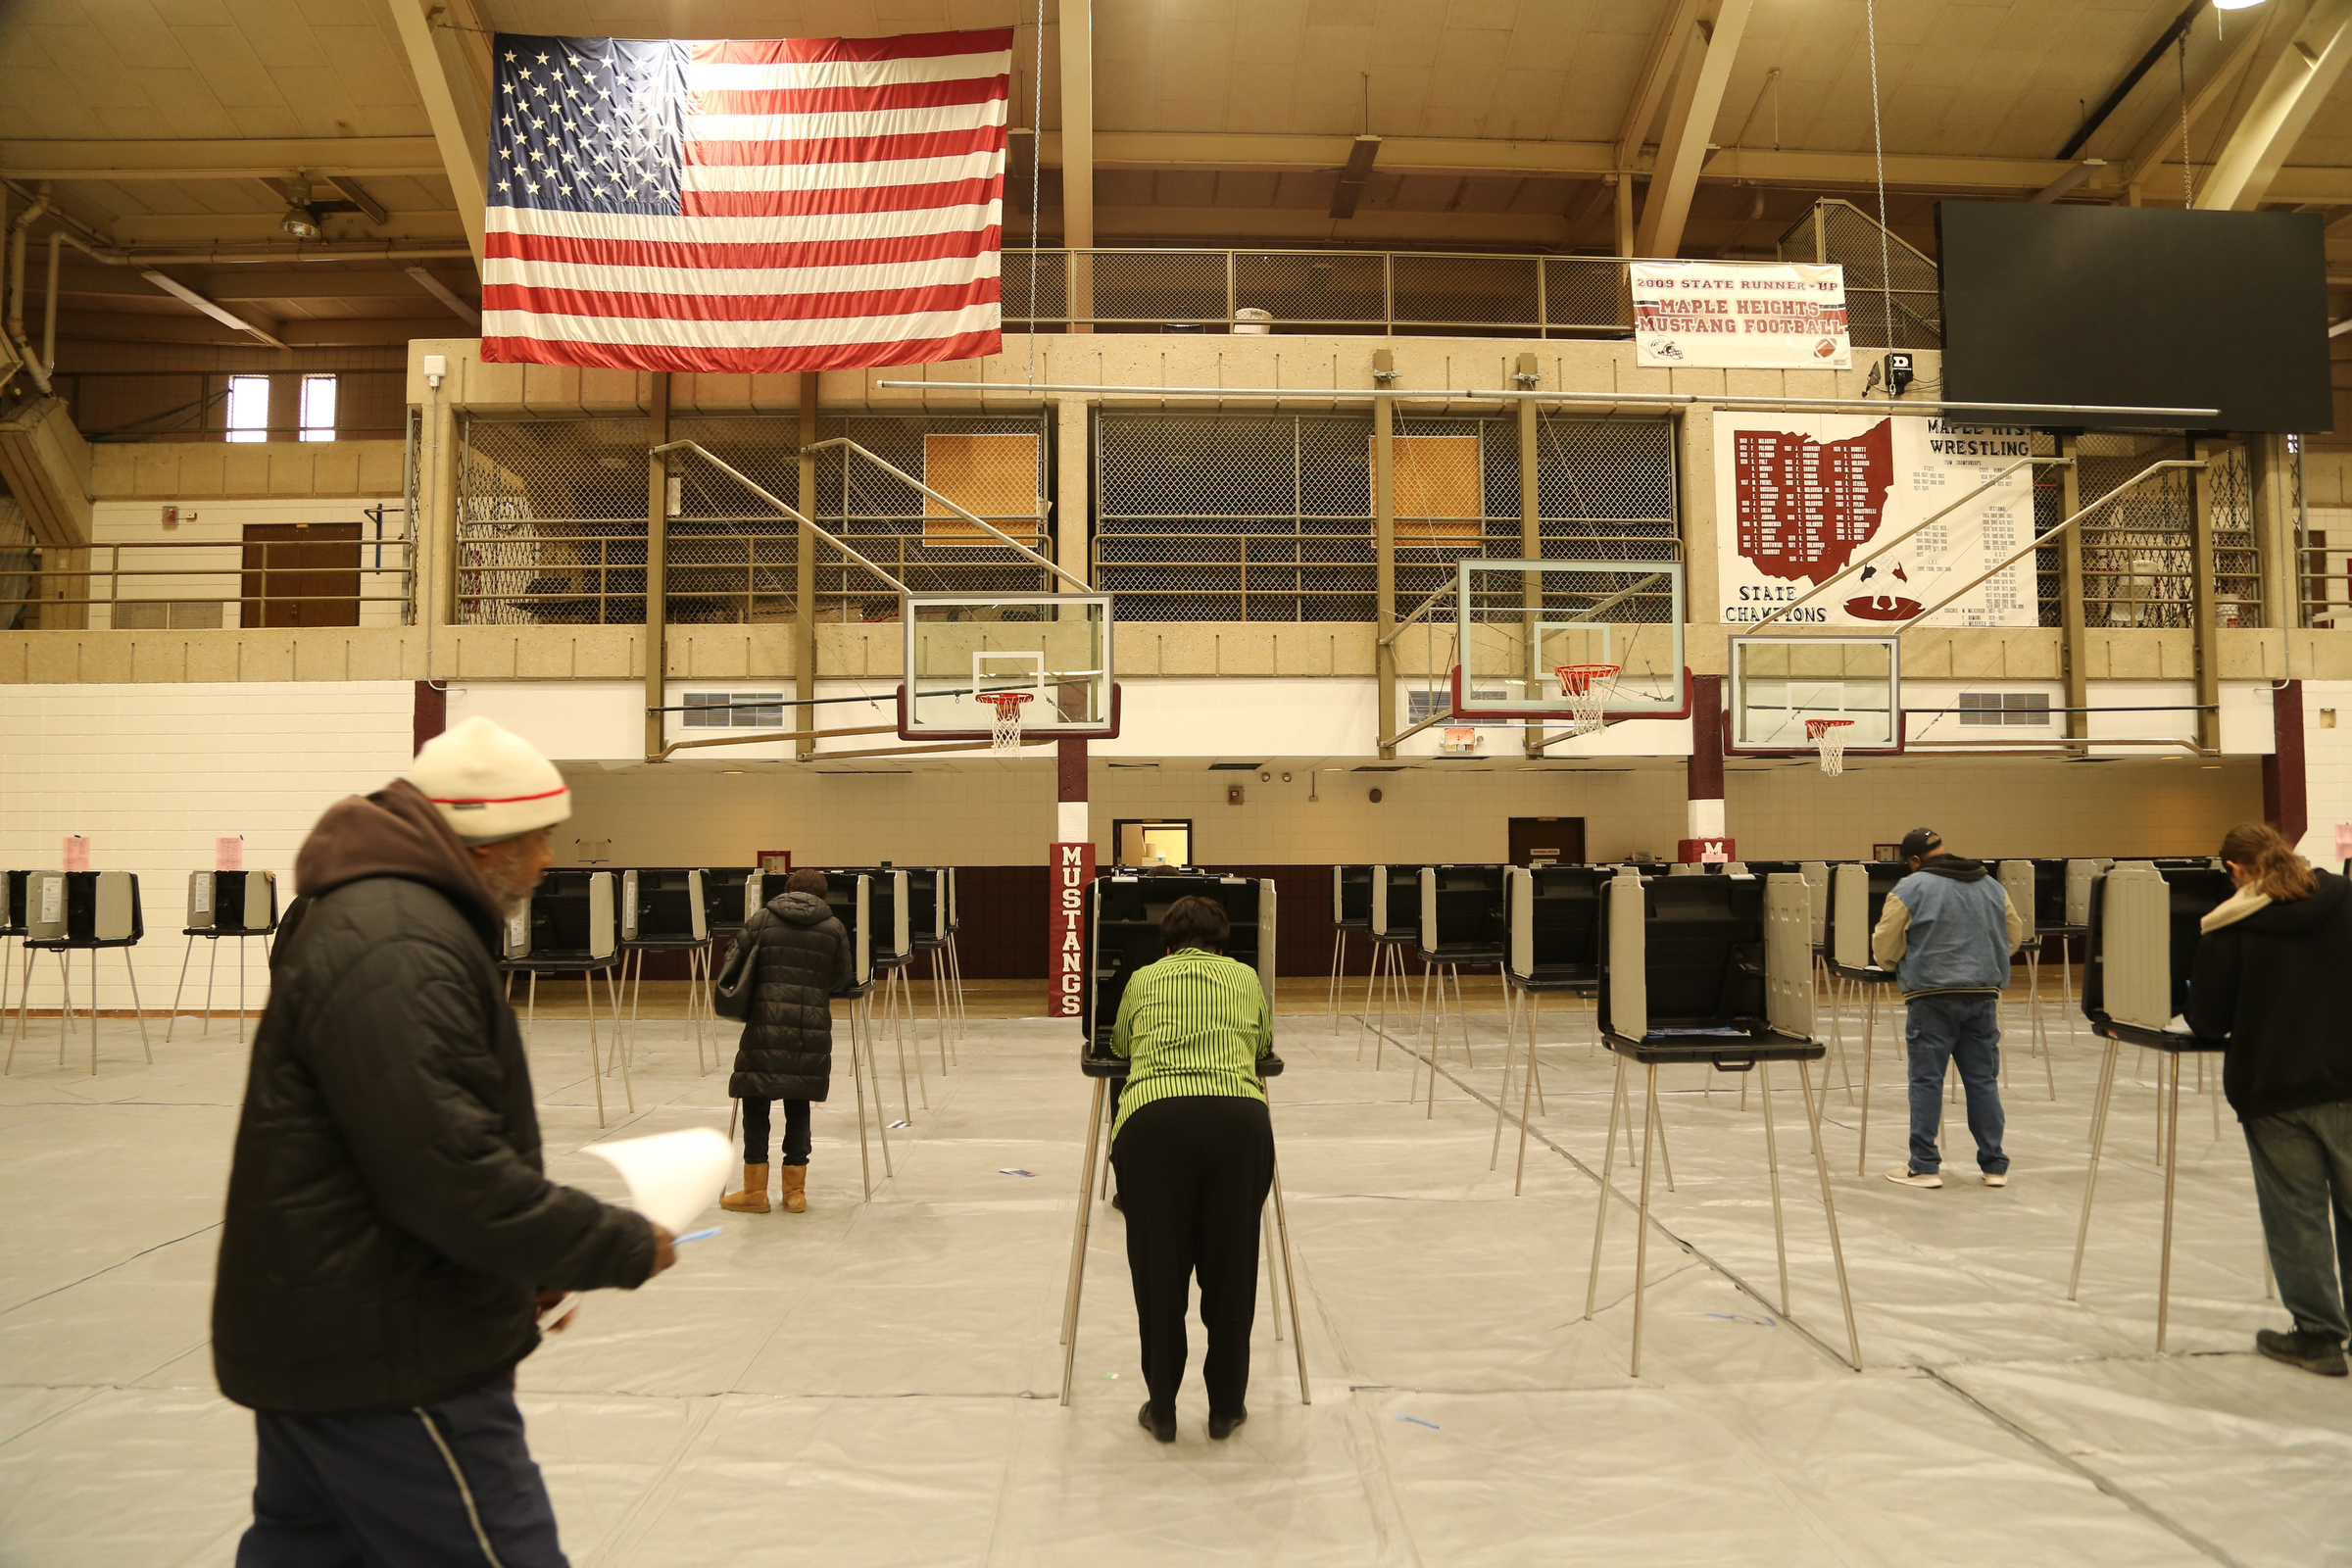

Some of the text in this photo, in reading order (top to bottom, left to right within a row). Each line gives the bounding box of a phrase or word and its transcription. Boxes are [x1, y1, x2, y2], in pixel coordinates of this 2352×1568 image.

[1638, 278, 1674, 288] 2009
[1682, 279, 1734, 289] STATE
[1659, 299, 1820, 316] MAPLE HEIGHTS
[1640, 318, 1844, 335] MUSTANG FOOTBALL
[1930, 440, 2030, 456] WRESTLING
[1740, 586, 1797, 601] STATE
[1061, 846, 1082, 1015] MUSTANGS
